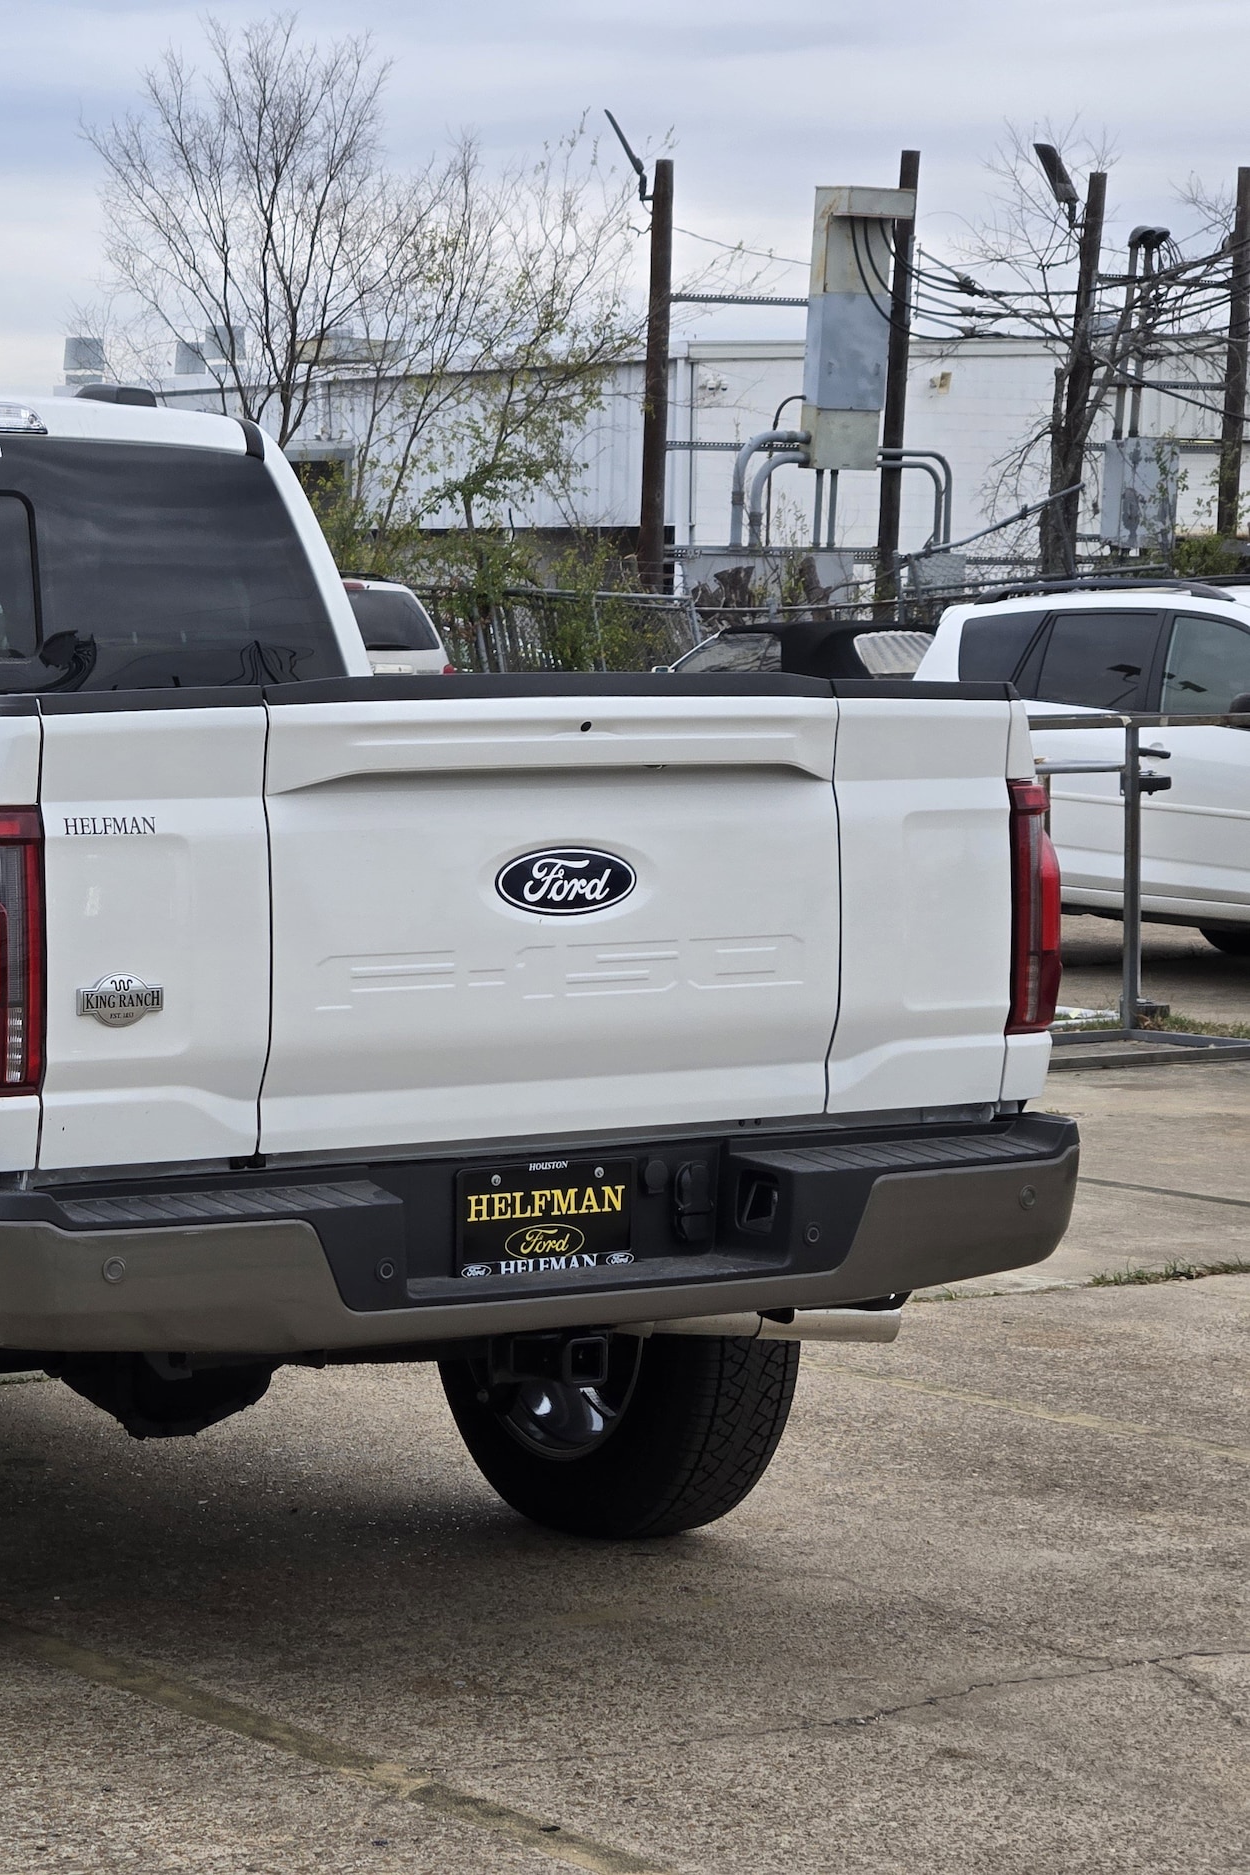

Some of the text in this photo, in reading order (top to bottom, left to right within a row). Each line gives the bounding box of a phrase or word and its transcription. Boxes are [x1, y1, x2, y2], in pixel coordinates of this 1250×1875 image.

[63, 816, 157, 836] HELFMAN
[523, 858, 612, 903] Ford
[85, 990, 161, 1009] KING RANCH
[528, 1160, 569, 1172] HOUSTON
[466, 1184, 626, 1222] HELFMAN
[520, 1228, 570, 1255] Ford
